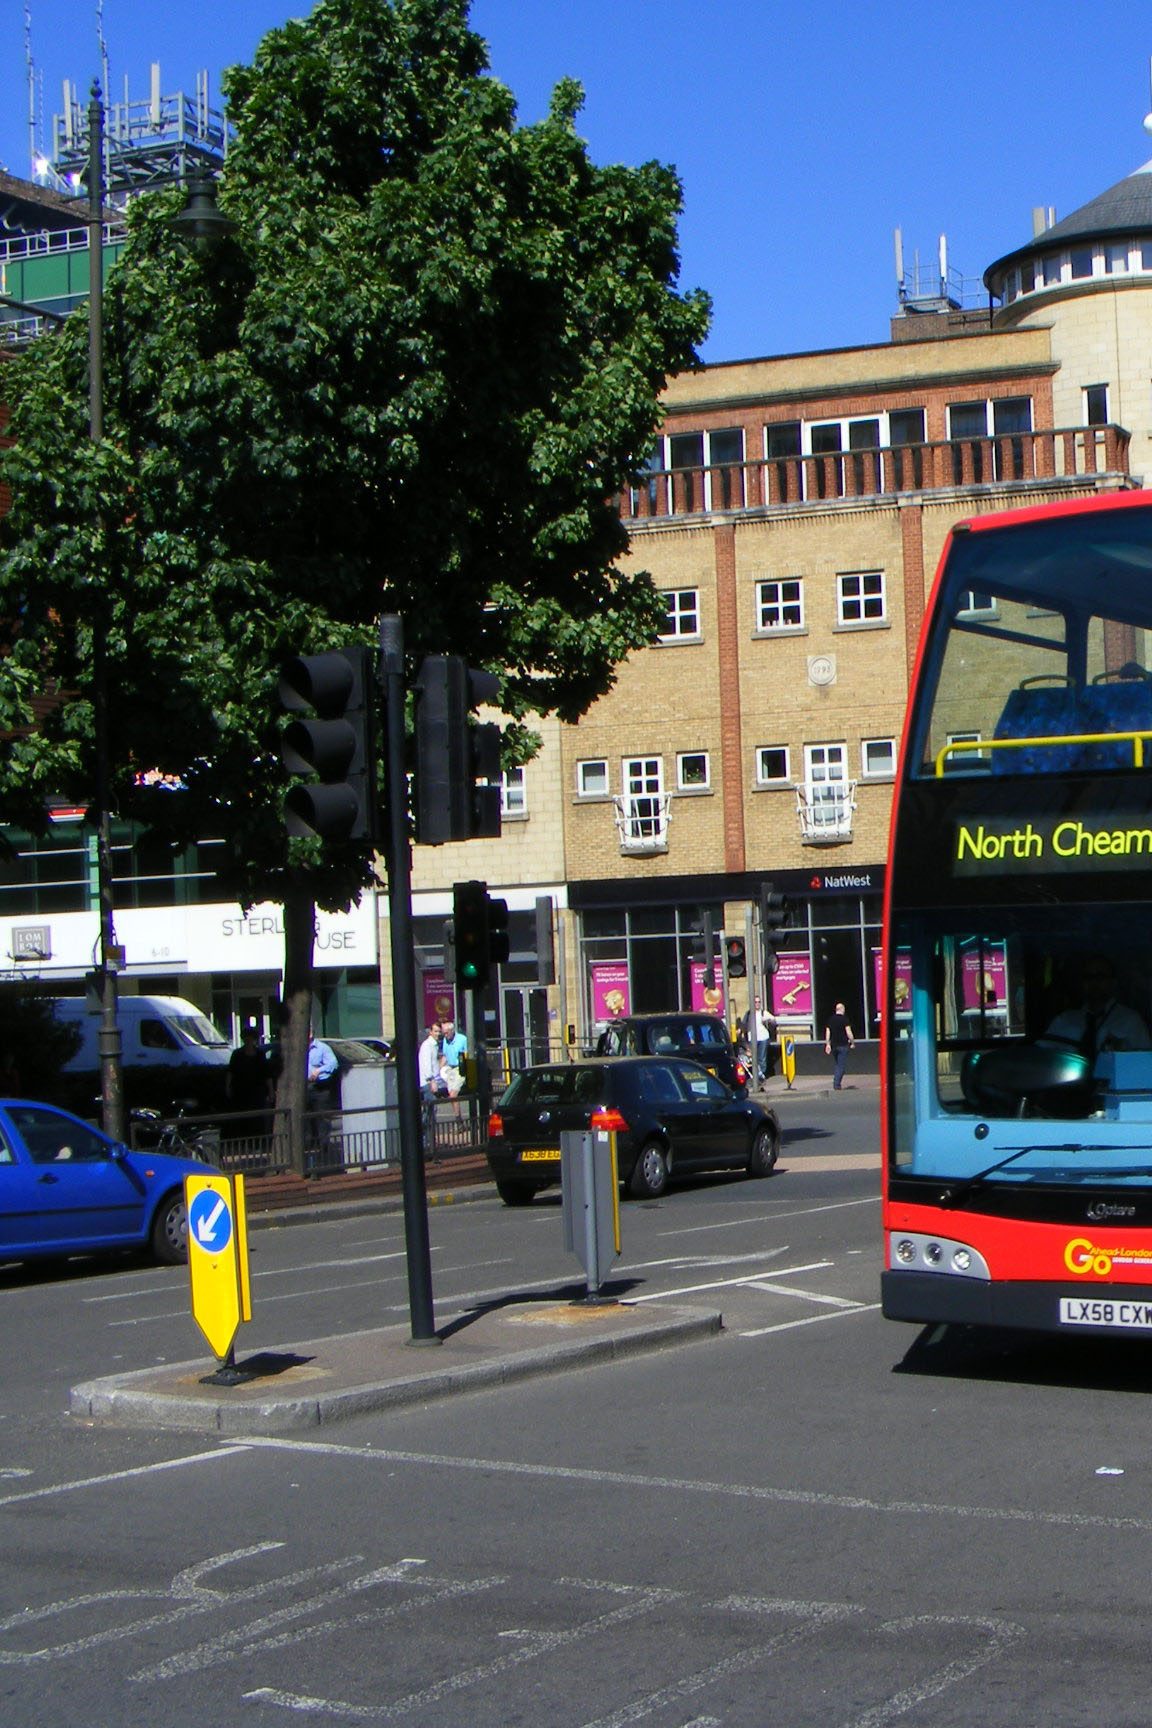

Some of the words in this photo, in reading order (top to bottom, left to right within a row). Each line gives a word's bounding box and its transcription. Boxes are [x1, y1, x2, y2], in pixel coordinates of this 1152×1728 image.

[957, 824, 1043, 860] North
[824, 874, 871, 888] NatWest
[316, 931, 357, 949] USE
[1095, 1203, 1136, 1218] Optare
[1064, 1238, 1112, 1275] Go
[1067, 1302, 1114, 1322] LX58
